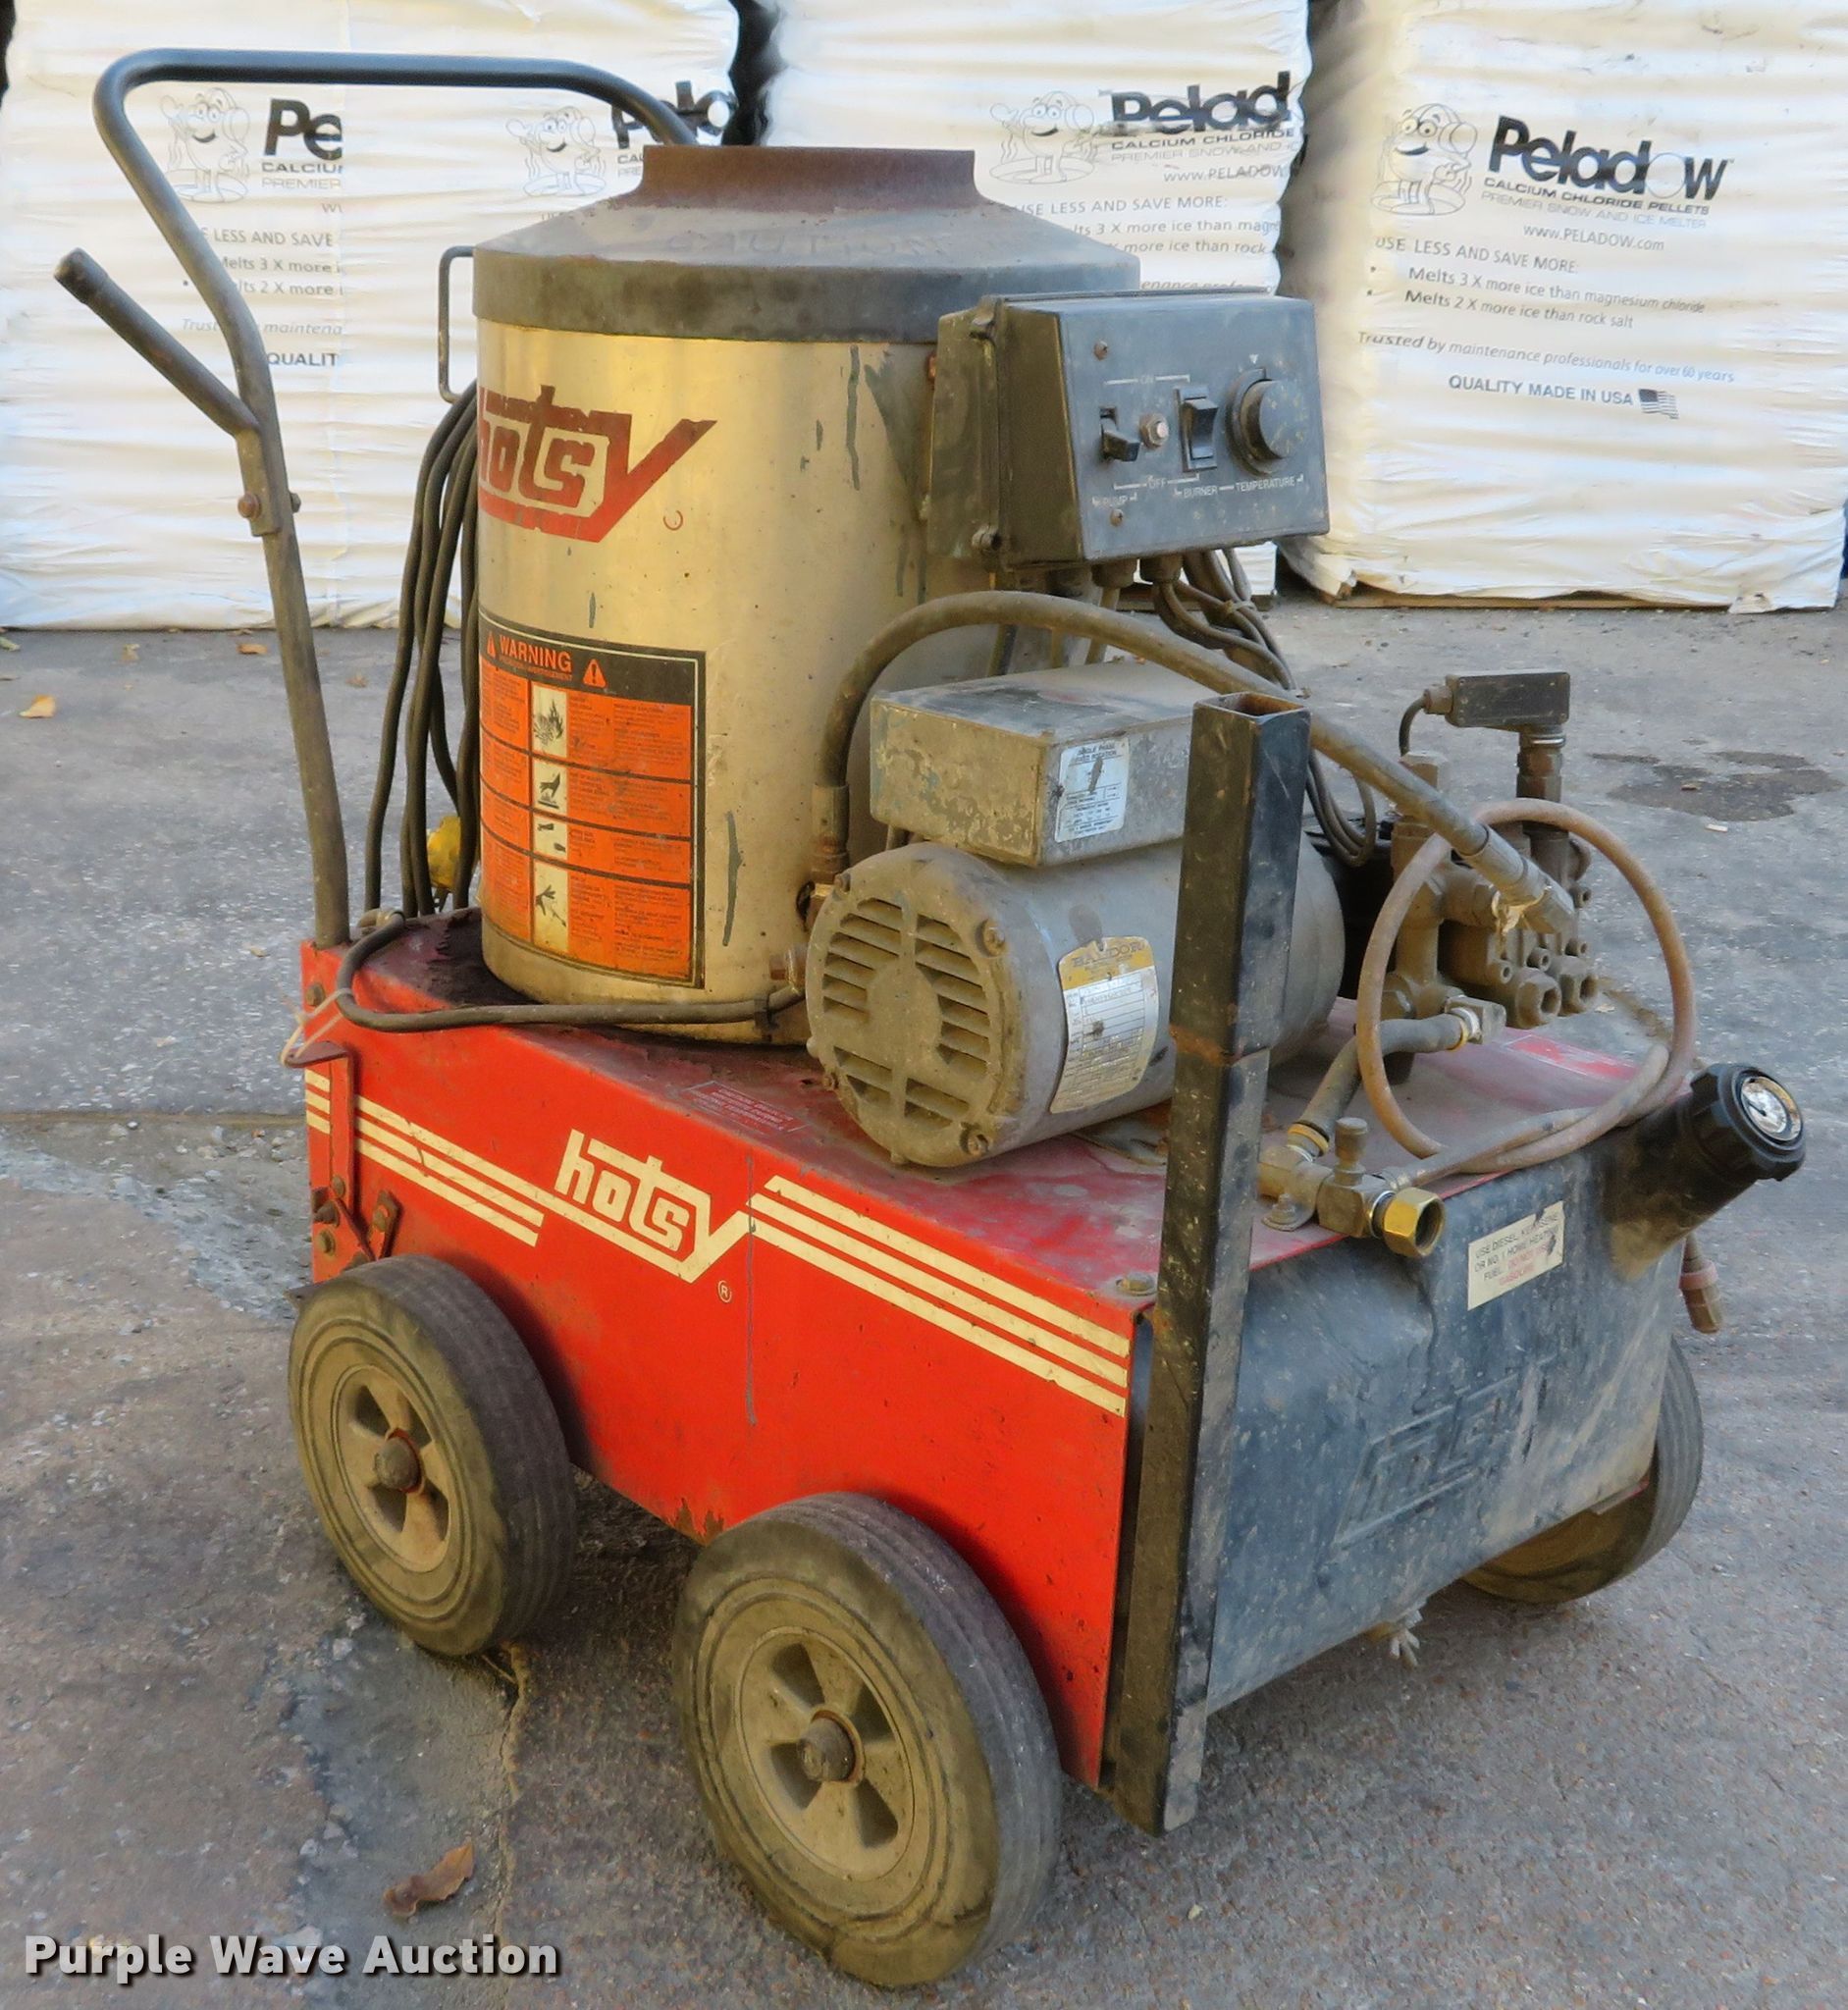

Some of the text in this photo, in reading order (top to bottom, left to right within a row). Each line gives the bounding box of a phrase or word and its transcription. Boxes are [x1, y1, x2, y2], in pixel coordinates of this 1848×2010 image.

[1112, 130, 1295, 149] CALCIUM CHLORIDE
[1050, 201, 1085, 214] LESS
[1091, 199, 1128, 213] AND
[1133, 197, 1172, 211] SAVE
[1178, 195, 1228, 209] MORE:
[1481, 191, 1707, 229] PREMIER SNOW AND ICE MELTER
[1484, 177, 1710, 216] CALCIUM CHLORIDE PELLETS
[214, 229, 246, 243] LESS
[251, 232, 287, 245] AND
[291, 233, 334, 247] SAVE
[1097, 223, 1105, 236] 3
[1111, 222, 1121, 234] X
[1127, 223, 1167, 235] more
[1172, 221, 1191, 233] ice
[1197, 220, 1232, 232] than
[1523, 225, 1664, 251] www.PELADOW.com
[1123, 242, 1163, 253] more
[1169, 240, 1189, 251] ice
[1195, 239, 1230, 251] than
[1234, 241, 1267, 254] rock
[1375, 237, 1405, 252] USE
[1414, 239, 1451, 256] LESS
[1455, 245, 1490, 261] AND
[1494, 250, 1529, 268] SAVE
[260, 257, 268, 270] 3
[274, 259, 285, 271] X
[289, 262, 332, 273] more
[260, 281, 269, 293] 2
[274, 282, 286, 294] X
[290, 285, 334, 295] more
[1408, 267, 1706, 313] Melts 3 X more ice than magnesium chloride
[1404, 290, 1633, 329] Melts 2 X more ice than rock salt
[1358, 331, 1735, 384] Trusted by maintenance professionals for over 60 years
[1449, 375, 1634, 405] QUALITY MADE IN USA
[1184, 486, 1218, 499] BURNER
[1235, 476, 1295, 493] TEMPERATURE
[499, 634, 572, 673] WARNING
[554, 1129, 748, 1284] hotsy
